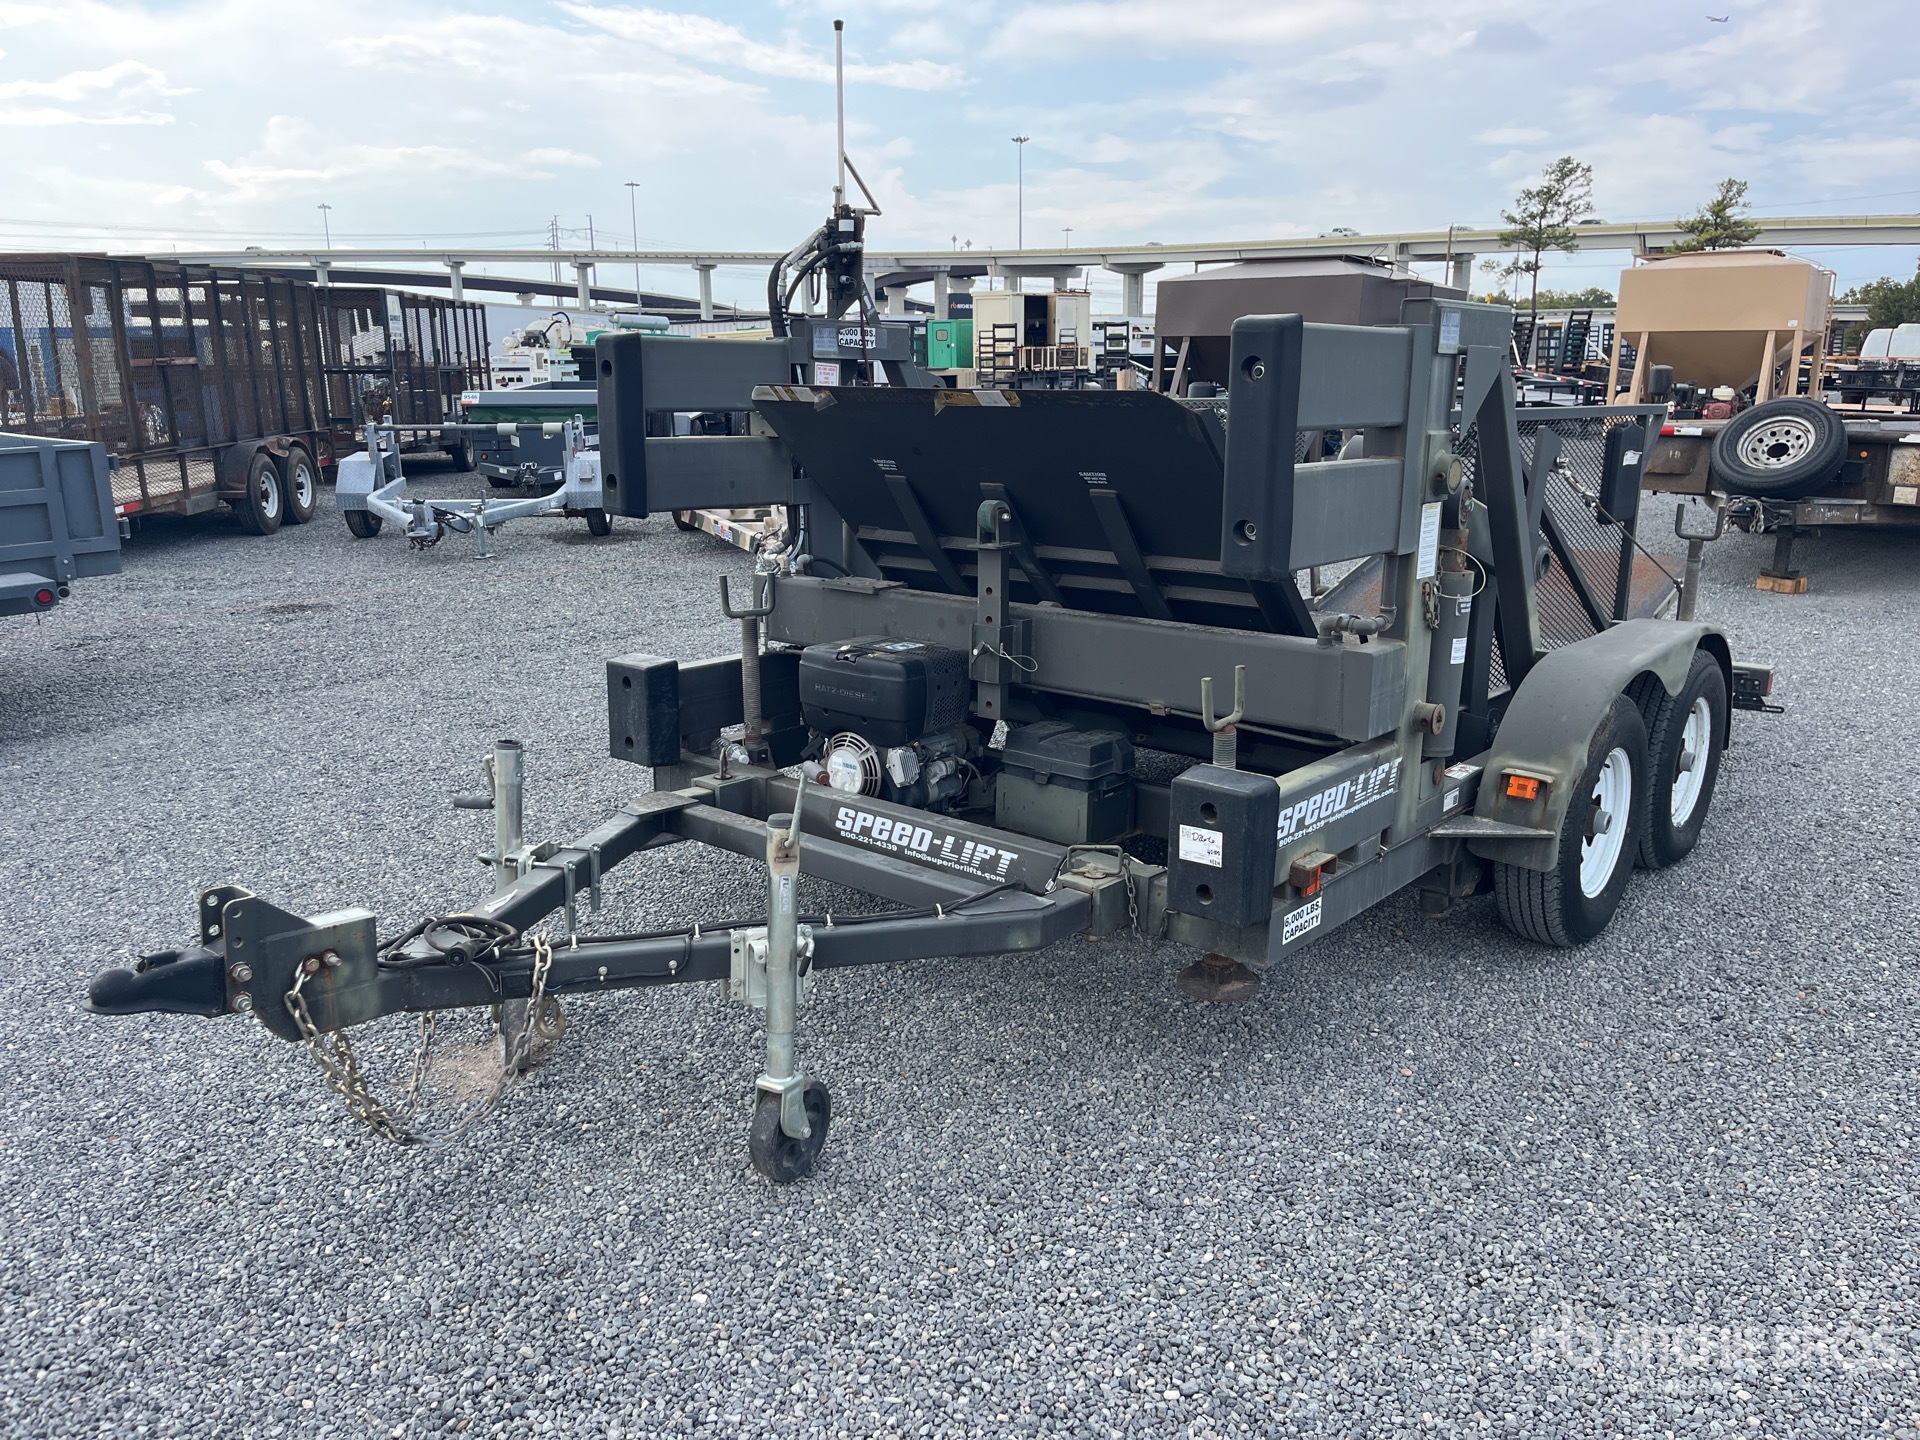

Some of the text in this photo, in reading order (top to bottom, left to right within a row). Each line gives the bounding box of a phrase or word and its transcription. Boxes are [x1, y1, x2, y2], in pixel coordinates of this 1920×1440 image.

[840, 338, 875, 347] CAPACTY
[1279, 820, 1325, 847] 800-221-4339
[840, 830, 1006, 883] 800-221-4339 info@superiorlifts.com
[1284, 909, 1304, 928] 6,000
[1284, 912, 1320, 941] CAPACITY
